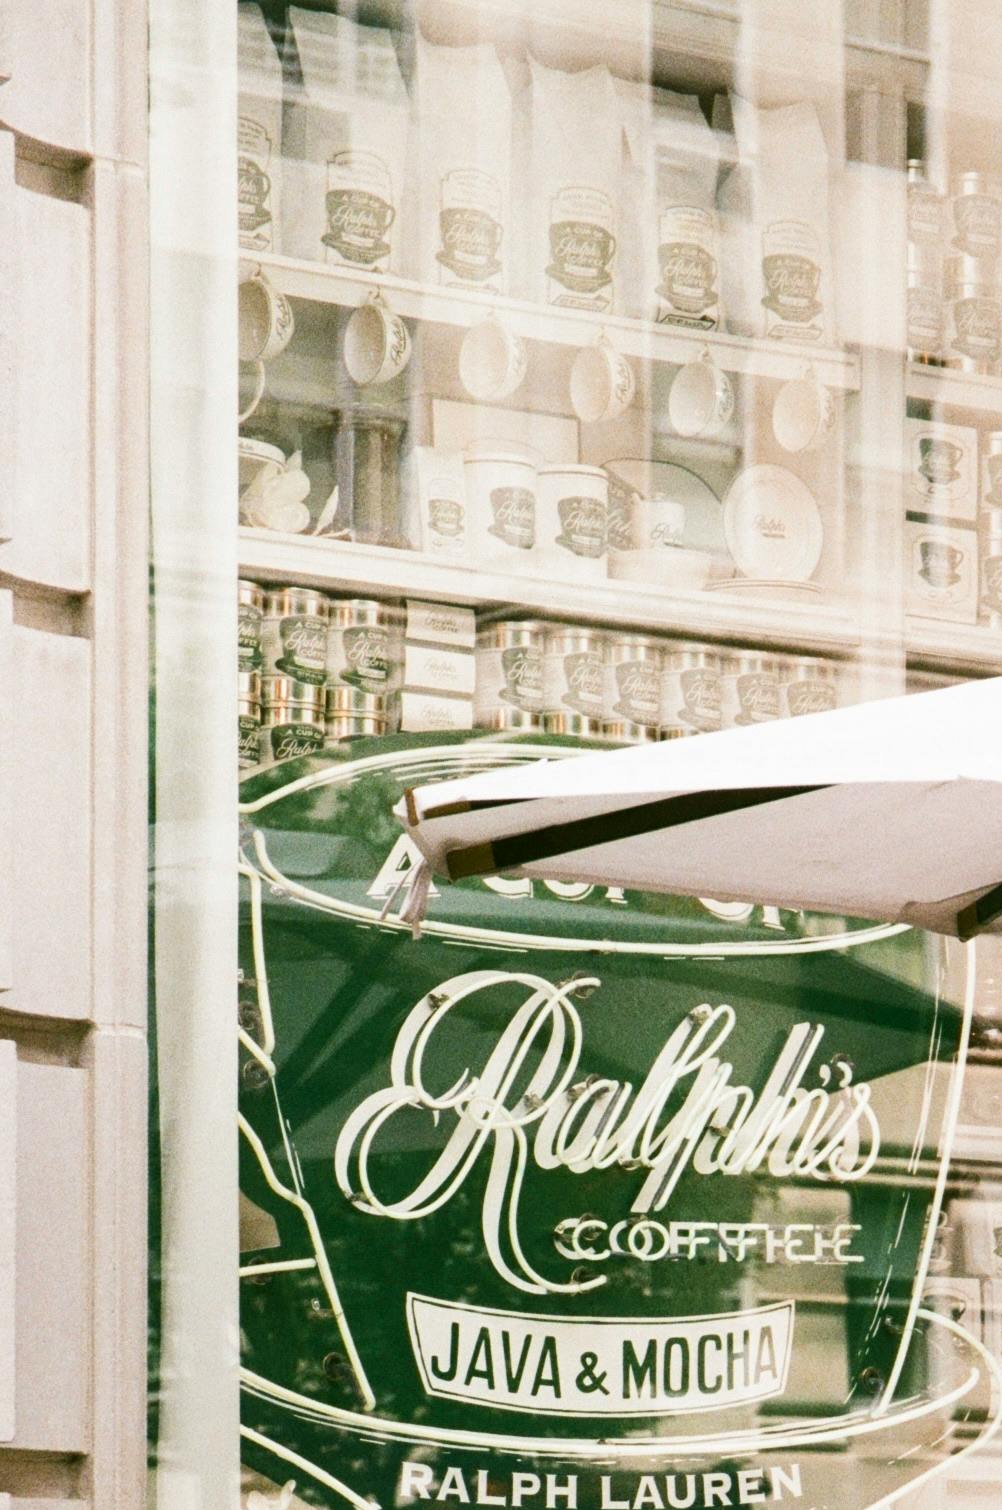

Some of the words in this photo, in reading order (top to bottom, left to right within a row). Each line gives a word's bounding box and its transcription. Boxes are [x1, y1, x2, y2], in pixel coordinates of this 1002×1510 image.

[366, 832, 441, 899] A
[334, 969, 881, 1295] Ralph's
[553, 1216, 865, 1265] COFFEE
[431, 1322, 562, 1399] JAVA
[575, 1351, 610, 1396] &
[622, 1325, 778, 1400] MOCHA
[401, 1461, 578, 1510] RALPH
[600, 1463, 803, 1510] LAUREN
